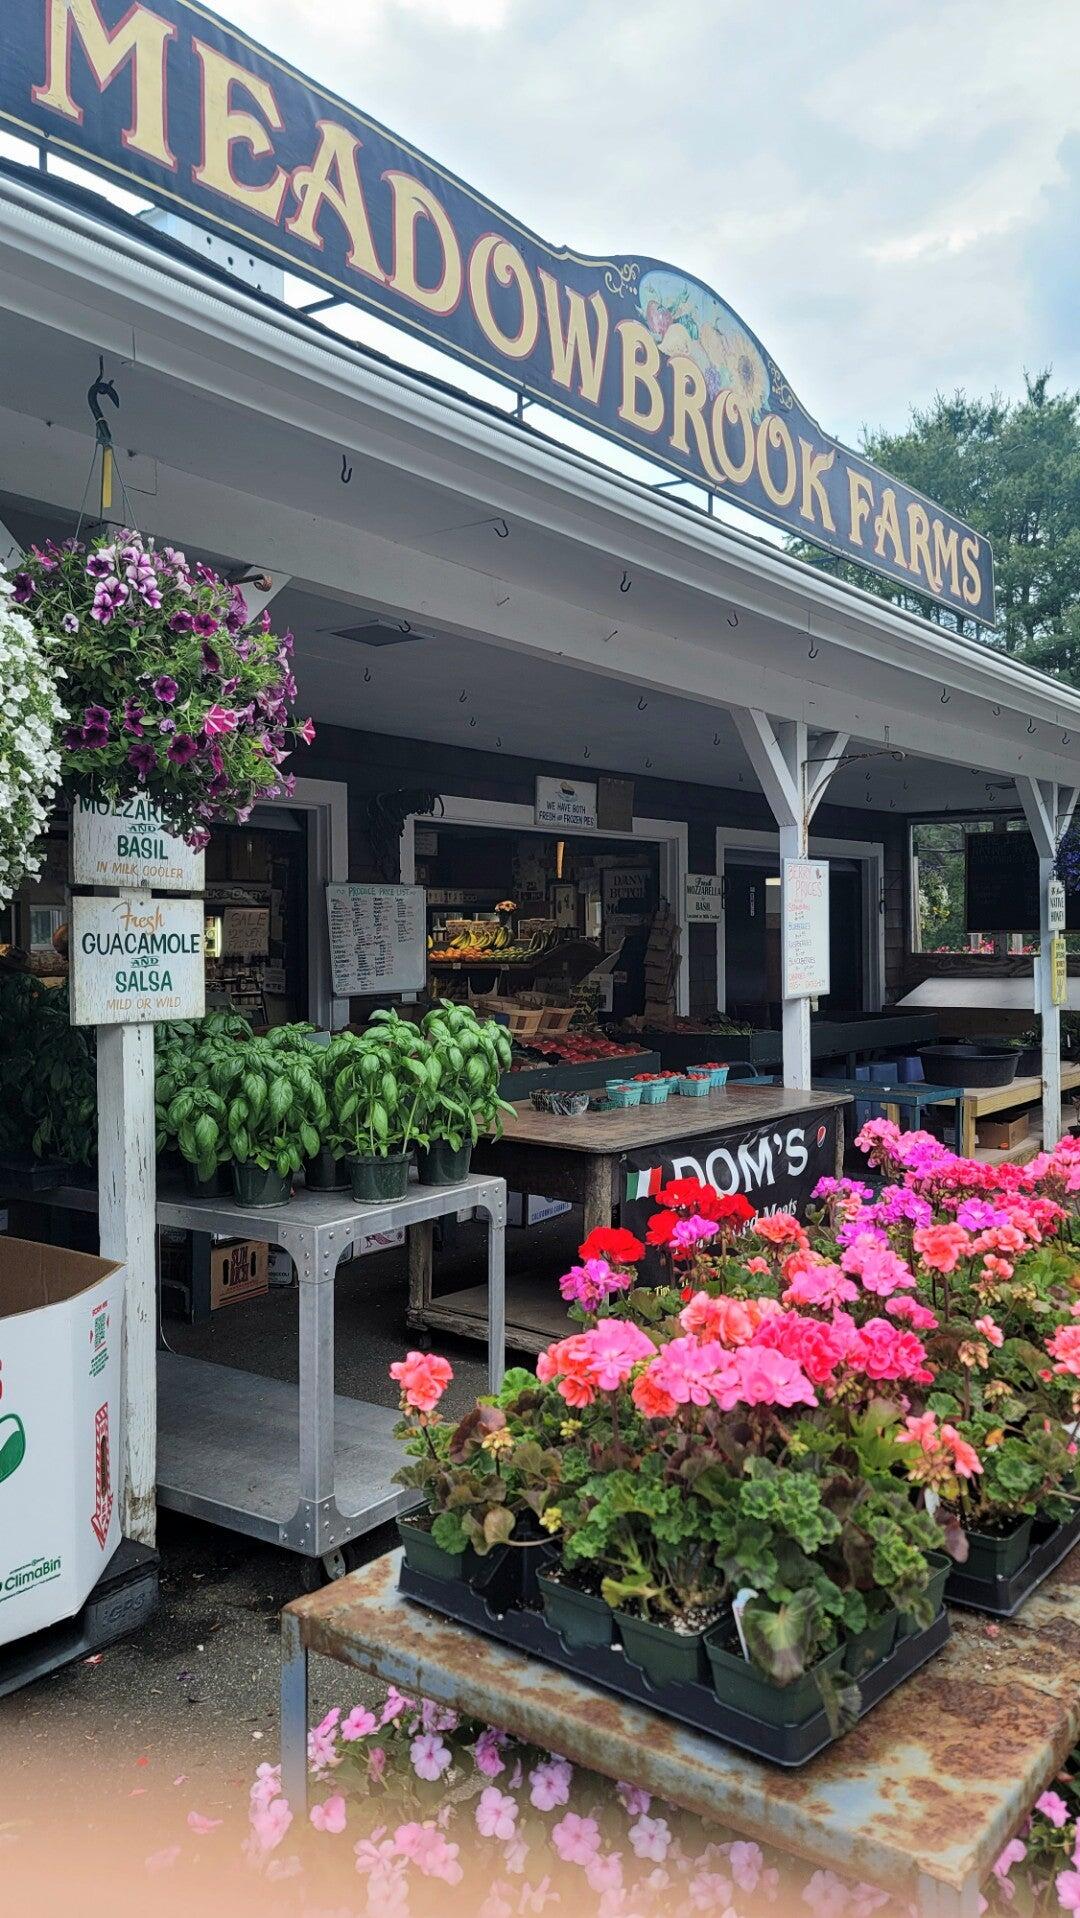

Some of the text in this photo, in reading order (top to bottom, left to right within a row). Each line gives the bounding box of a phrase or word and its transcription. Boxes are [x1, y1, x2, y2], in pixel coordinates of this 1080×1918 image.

[31, 0, 982, 607] MEADOWBROOK FARMS
[546, 801, 586, 814] WE HAVE BOTH
[538, 810, 556, 821] FRESH
[563, 814, 583, 824] FROZEN
[583, 816, 595, 826] PIES
[128, 825, 158, 833] AND
[117, 835, 168, 860] BASIL
[96, 861, 183, 879] IN MILK COOLER
[695, 877, 713, 886] Fresh
[687, 886, 721, 896] MOZZARELLA
[695, 901, 712, 911] BASIL
[112, 901, 165, 936] Fresh
[82, 932, 201, 955] GUACAMOLE
[131, 958, 159, 966] AND
[115, 970, 173, 993] SALSA
[106, 996, 182, 1011] MILD OR WILD
[671, 1128, 809, 1198] DOM'S
[4, 1558, 61, 1591] ClimaBin
